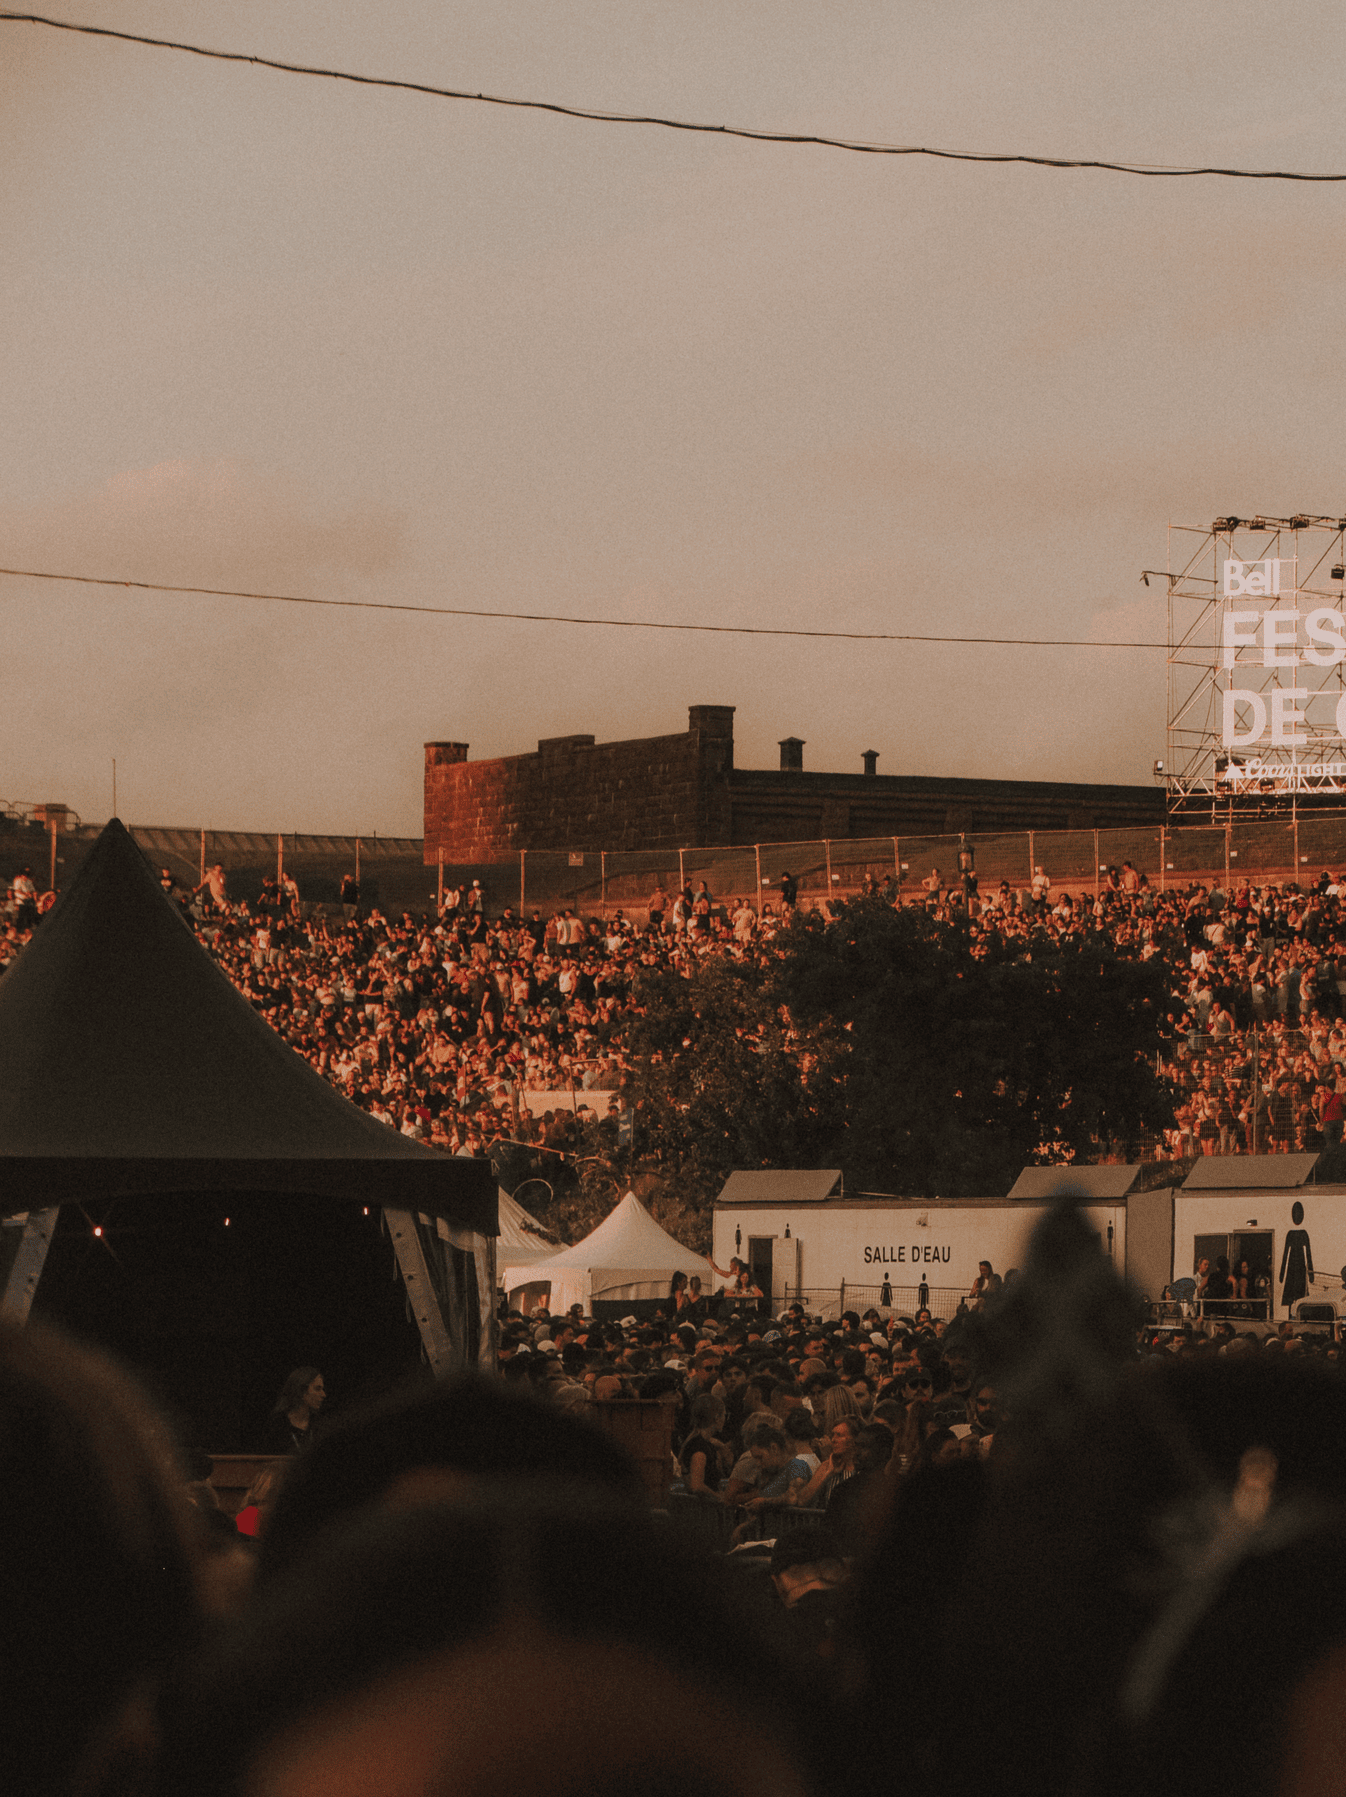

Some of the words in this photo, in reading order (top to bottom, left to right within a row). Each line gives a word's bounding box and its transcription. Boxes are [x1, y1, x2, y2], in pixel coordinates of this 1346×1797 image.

[1223, 559, 1280, 596] Bell
[1222, 687, 1308, 746] DE
[864, 1246, 906, 1263] SALLE
[911, 1246, 951, 1263] D'EAU
